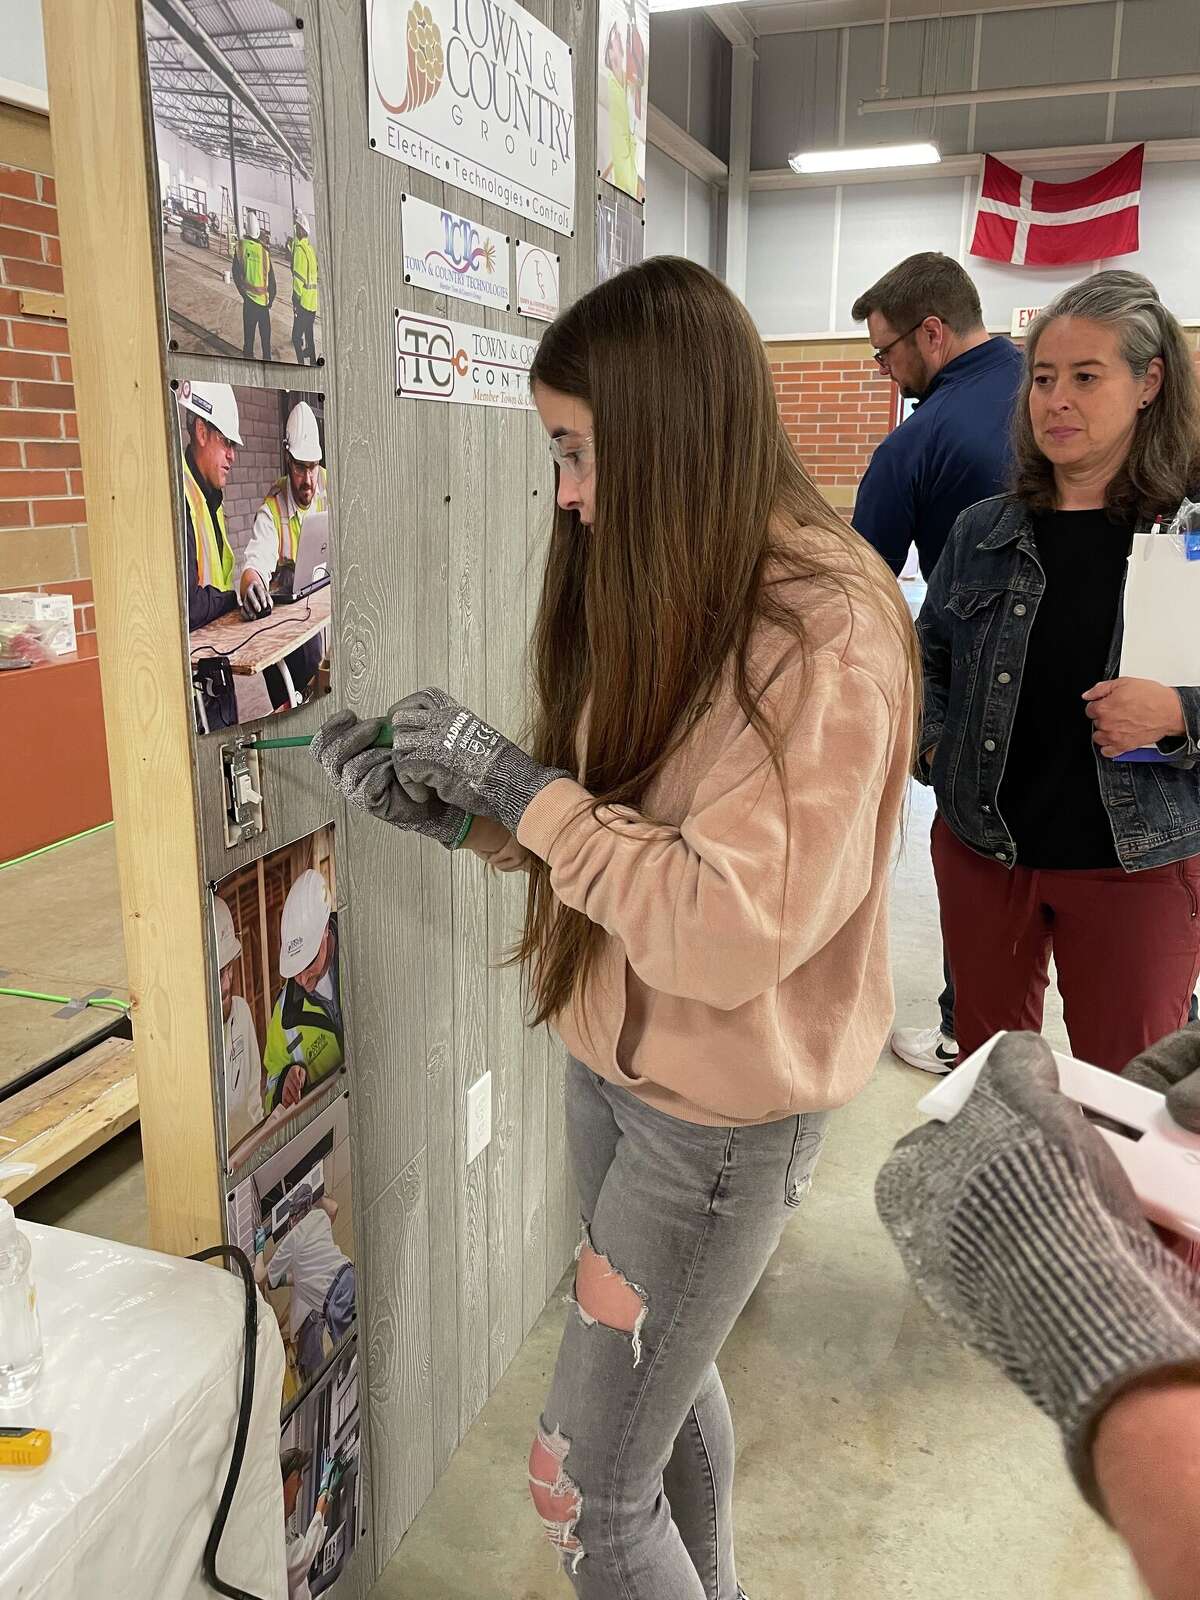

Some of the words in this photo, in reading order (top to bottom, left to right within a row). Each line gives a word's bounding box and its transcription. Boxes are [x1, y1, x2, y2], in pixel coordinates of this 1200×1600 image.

[543, 50, 559, 96] &
[447, 36, 572, 164] COUNTRY
[451, 104, 558, 176] GROUP
[387, 126, 441, 169] Electric
[453, 157, 523, 207] Technologies
[532, 197, 569, 229] Controls
[405, 255, 427, 273] TOWN
[427, 263, 434, 276] &
[435, 265, 465, 285] COUNTRY
[466, 275, 509, 298] TECHNOLOGIES
[1019, 308, 1041, 328] EX
[472, 334, 507, 360] TOWN
[511, 343, 518, 360] &
[472, 367, 532, 389] CONT
[472, 387, 499, 402] Member
[500, 391, 517, 405] Town
[443, 712, 470, 750] RADNOR
